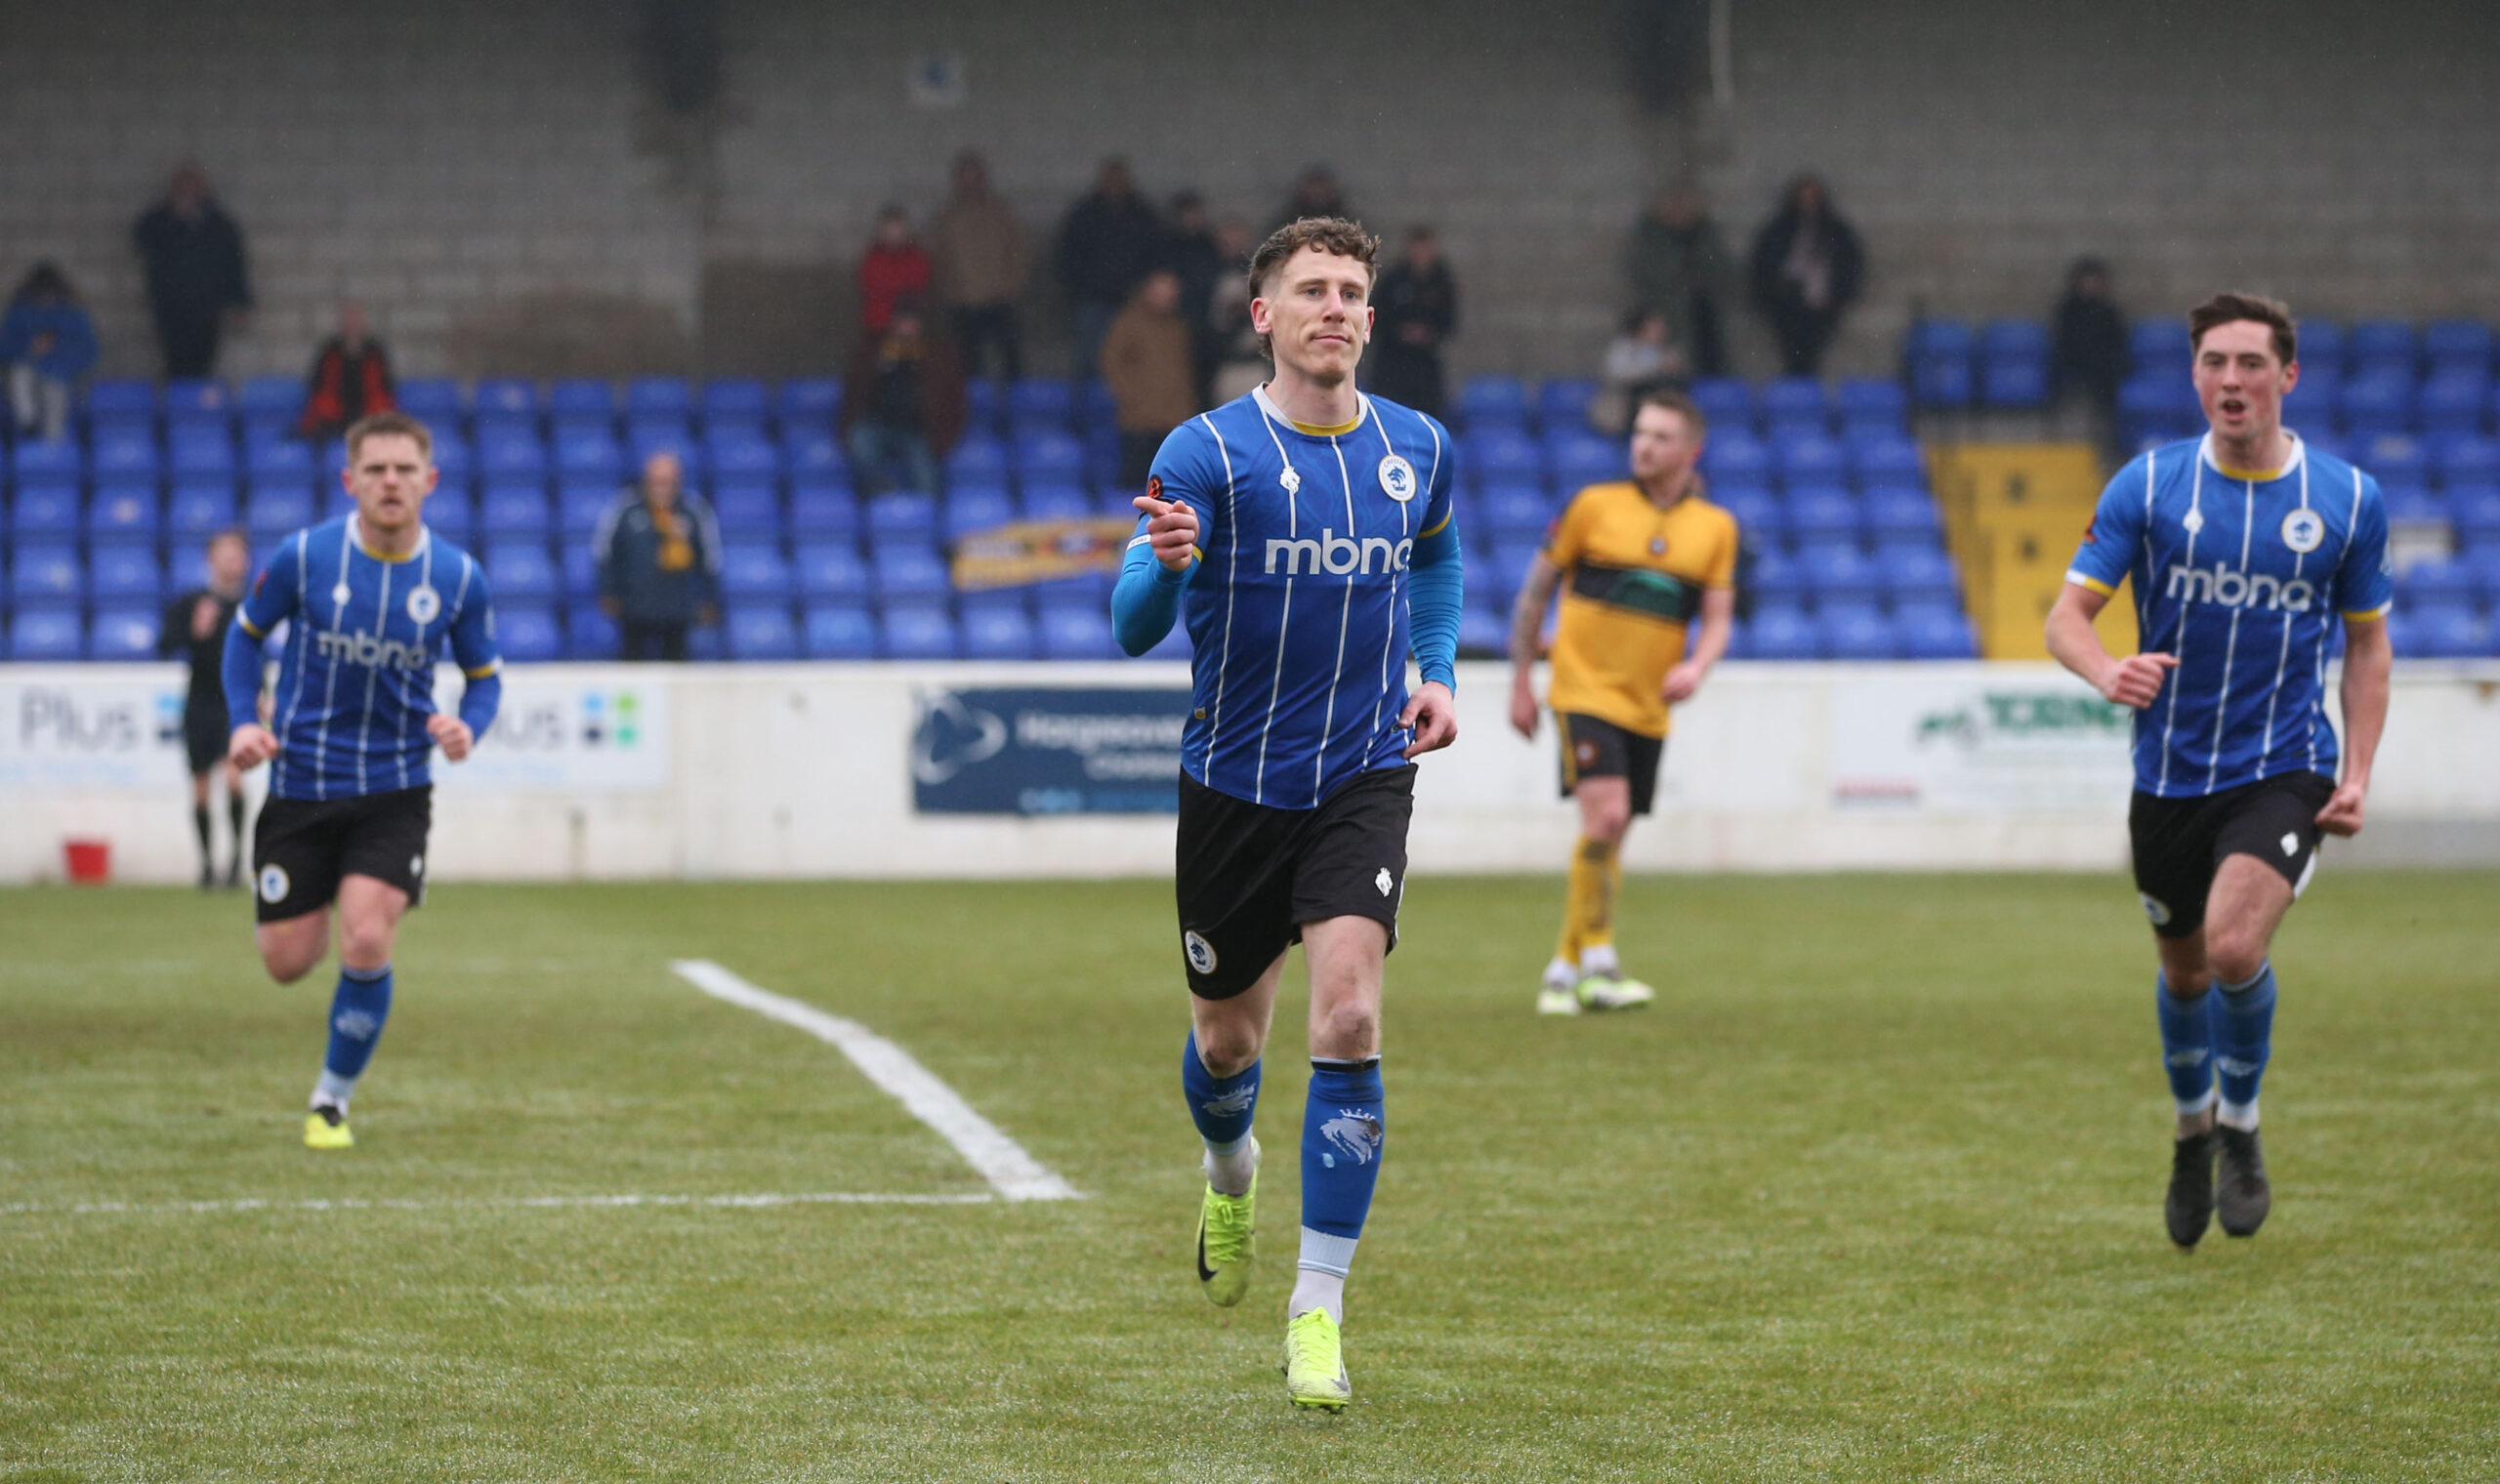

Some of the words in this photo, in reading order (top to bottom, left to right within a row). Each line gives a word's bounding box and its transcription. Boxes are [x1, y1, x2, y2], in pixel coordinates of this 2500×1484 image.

[2165, 561, 2314, 612] mbna
[317, 628, 427, 670] mbna
[20, 685, 140, 752] Plus
